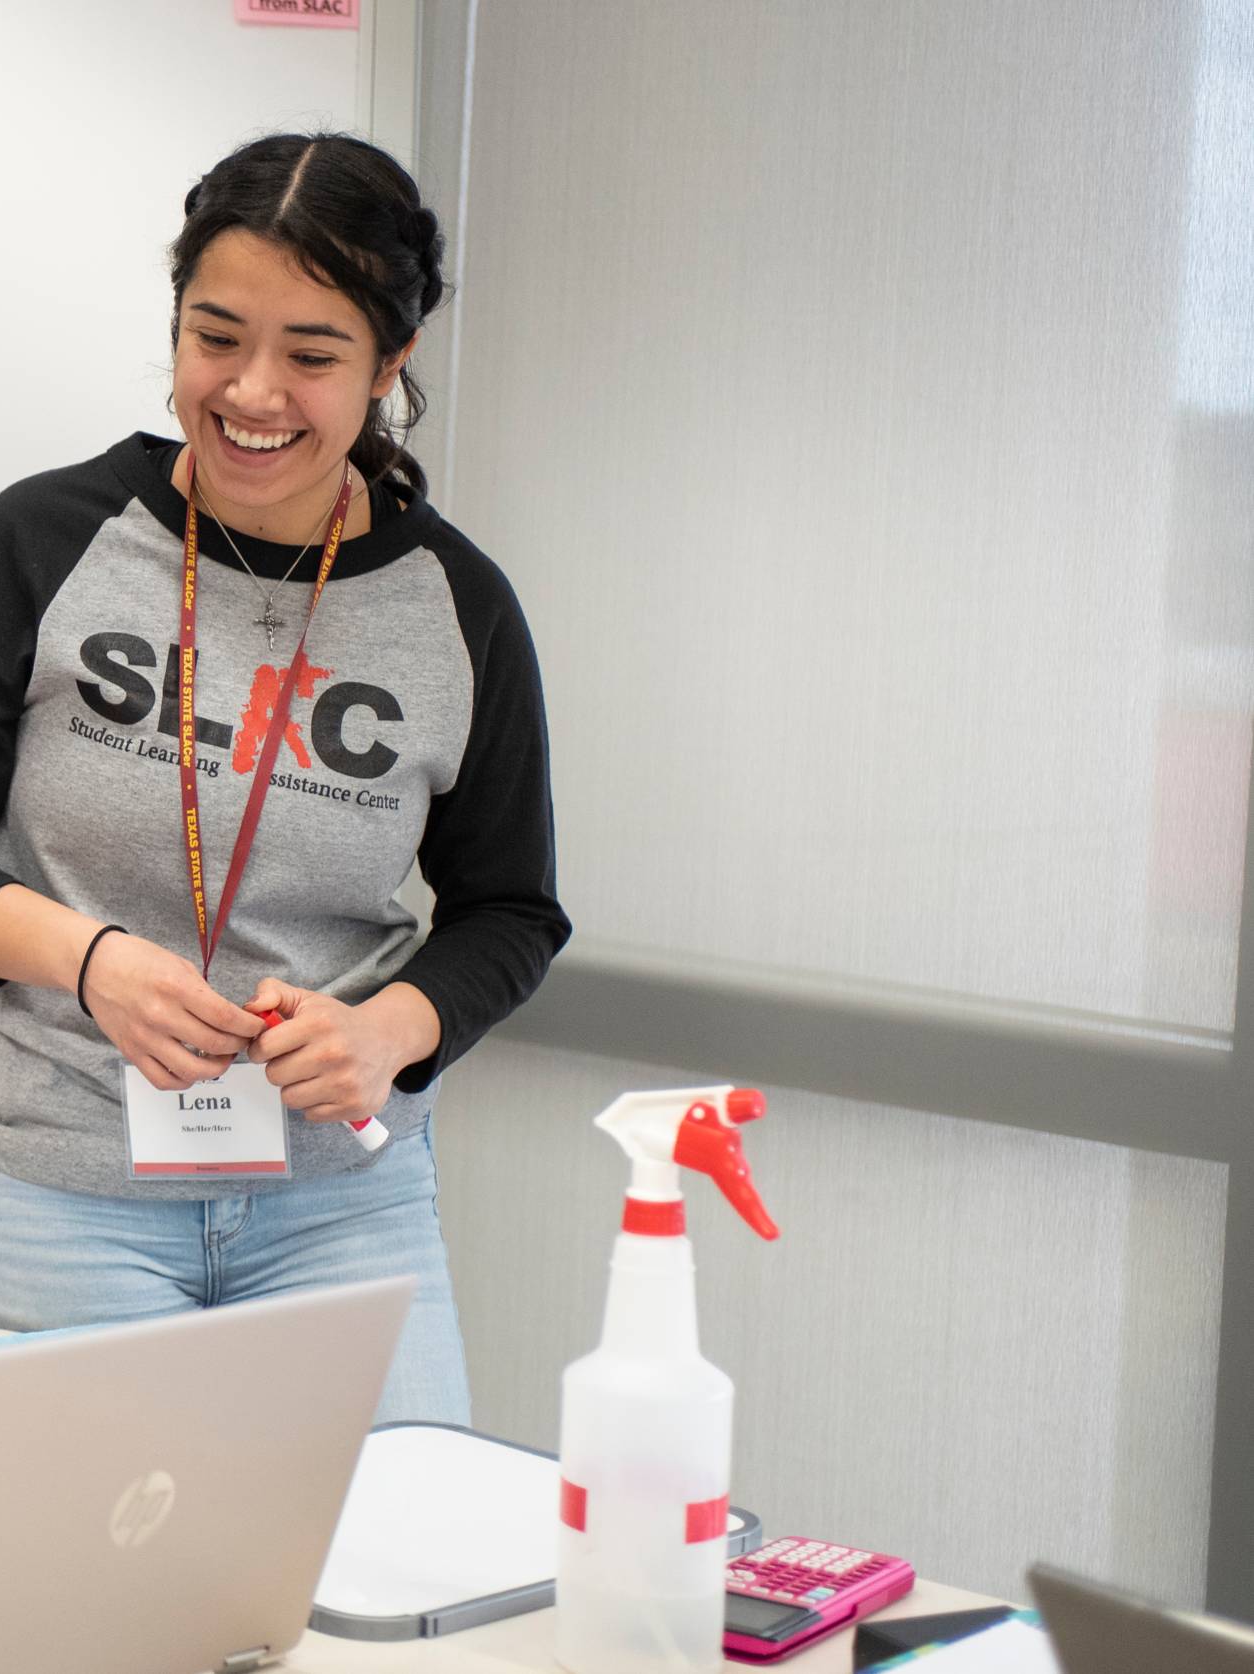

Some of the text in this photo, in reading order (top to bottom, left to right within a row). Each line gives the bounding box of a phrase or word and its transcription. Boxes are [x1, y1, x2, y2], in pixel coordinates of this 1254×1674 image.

[182, 647, 193, 769] TEXAS STATE SLACer
[69, 716, 133, 753] Student
[268, 773, 351, 801] ssistance
[356, 790, 401, 810] Center
[186, 808, 206, 935] TEXAS STATE SLACer
[178, 1093, 232, 1111] Lena
